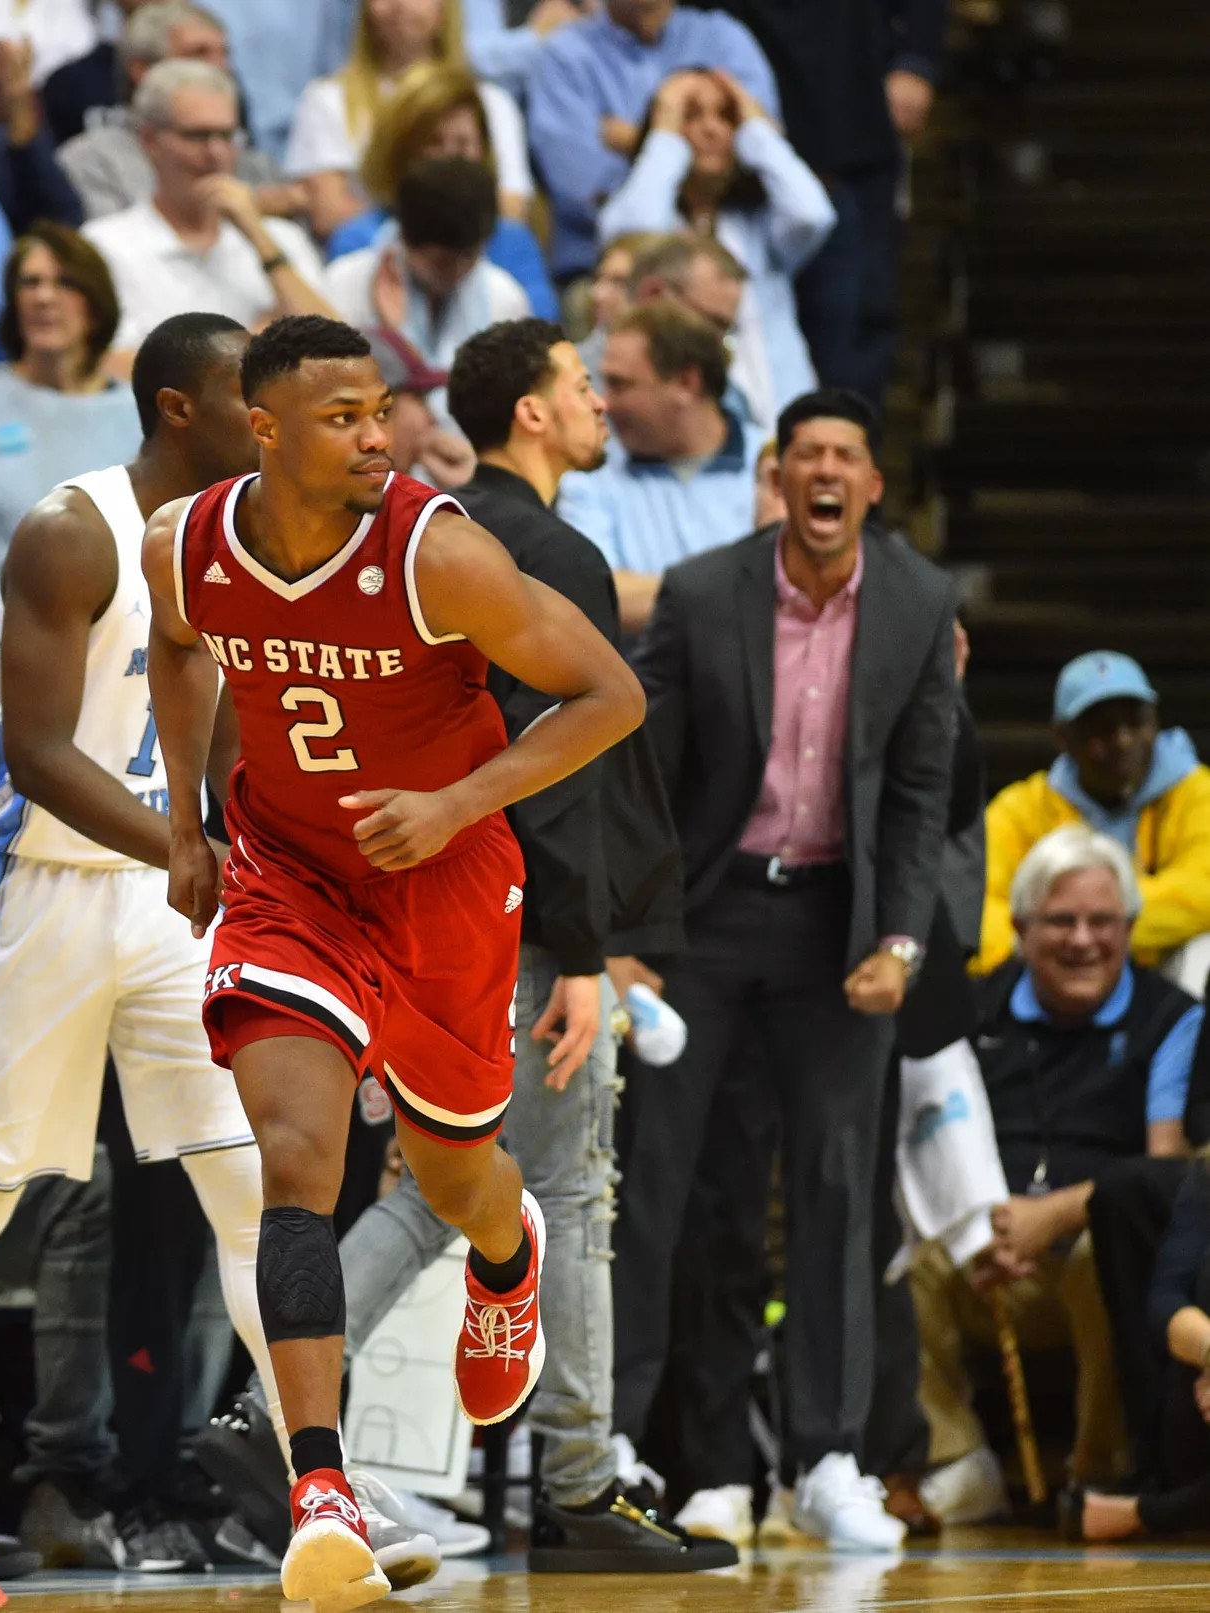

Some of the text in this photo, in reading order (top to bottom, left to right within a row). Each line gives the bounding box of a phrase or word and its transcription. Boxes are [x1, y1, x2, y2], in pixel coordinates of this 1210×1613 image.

[201, 632, 404, 680] NC STATE
[280, 686, 359, 772] 2
